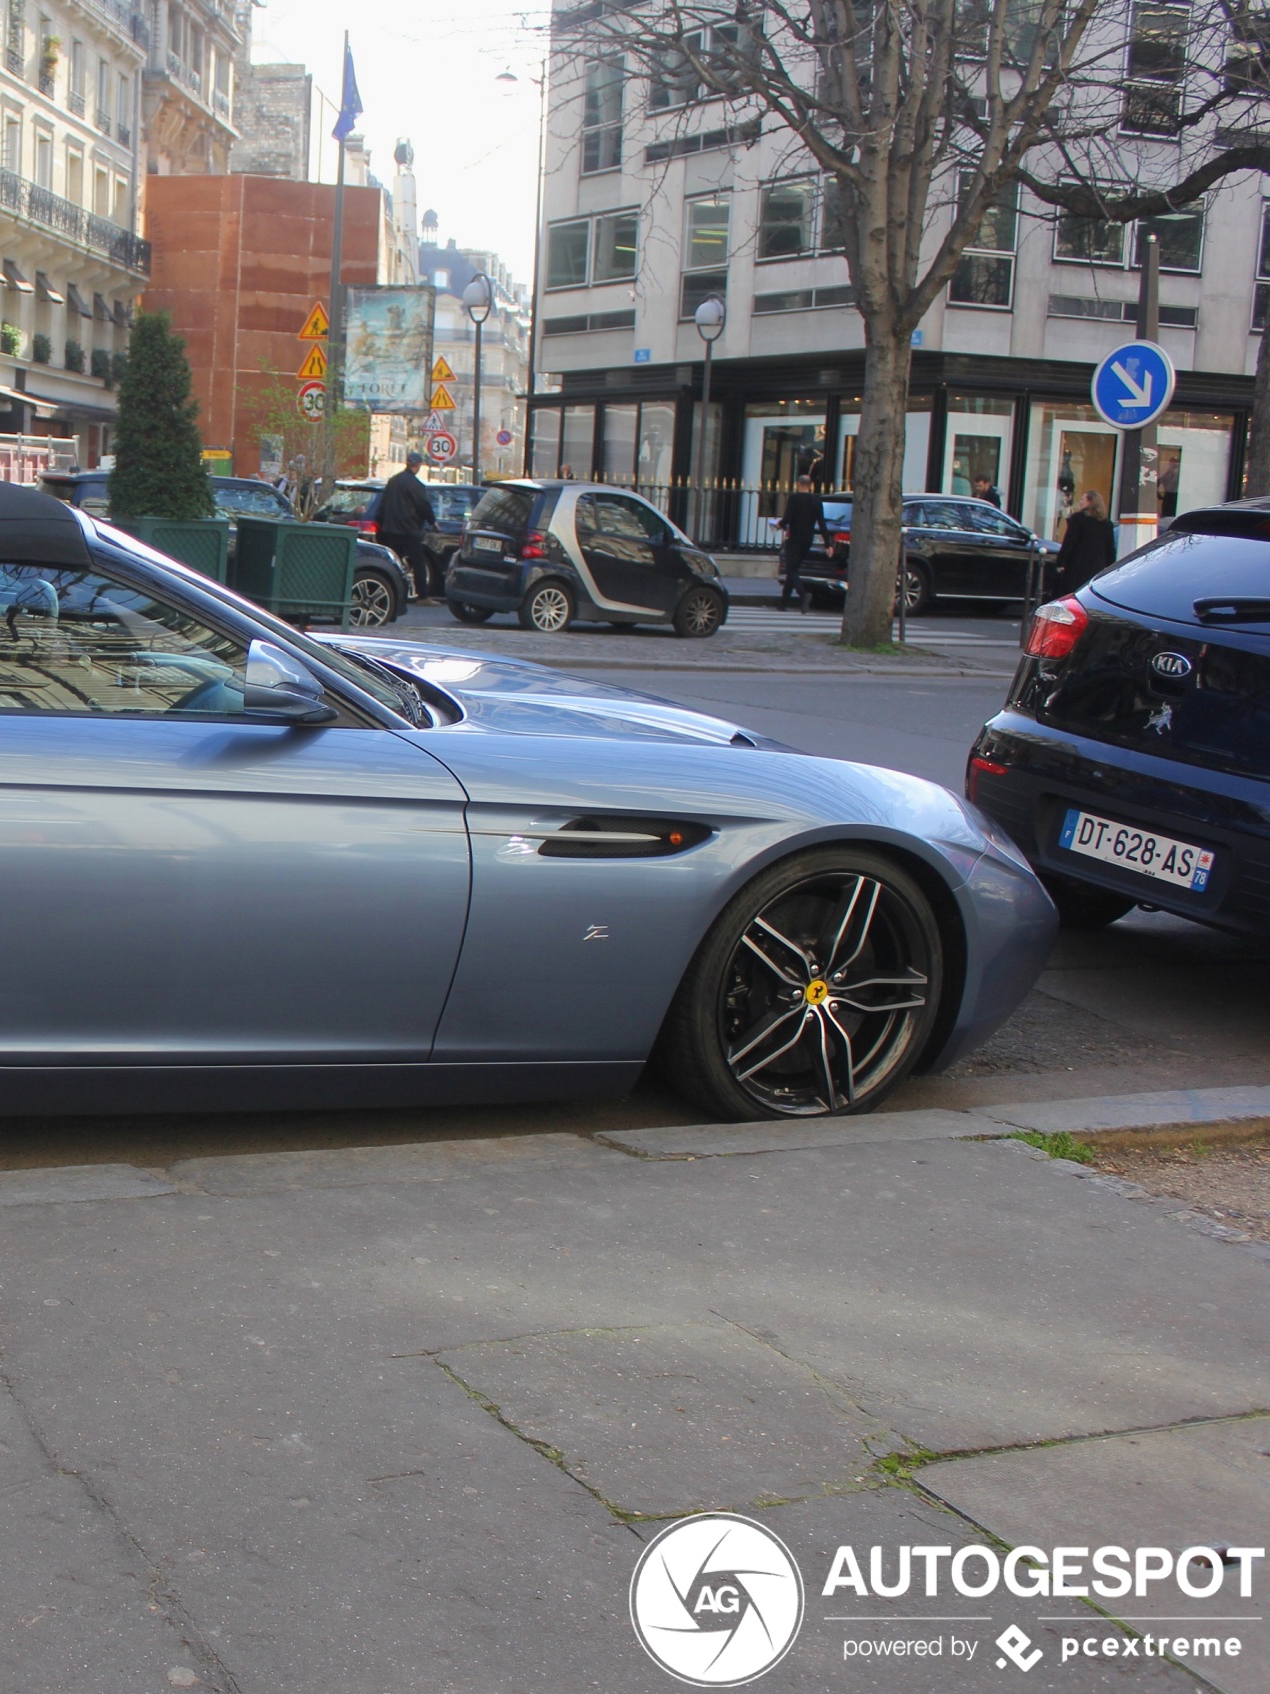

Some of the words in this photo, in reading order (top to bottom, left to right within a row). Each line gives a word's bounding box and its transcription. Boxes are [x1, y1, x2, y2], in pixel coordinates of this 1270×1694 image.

[305, 392, 326, 411] 30
[432, 440, 450, 453] 30
[1157, 656, 1183, 674] KIA
[1064, 830, 1071, 838] F
[1078, 817, 1194, 877] DT-628-AS
[1194, 870, 1207, 885] 78
